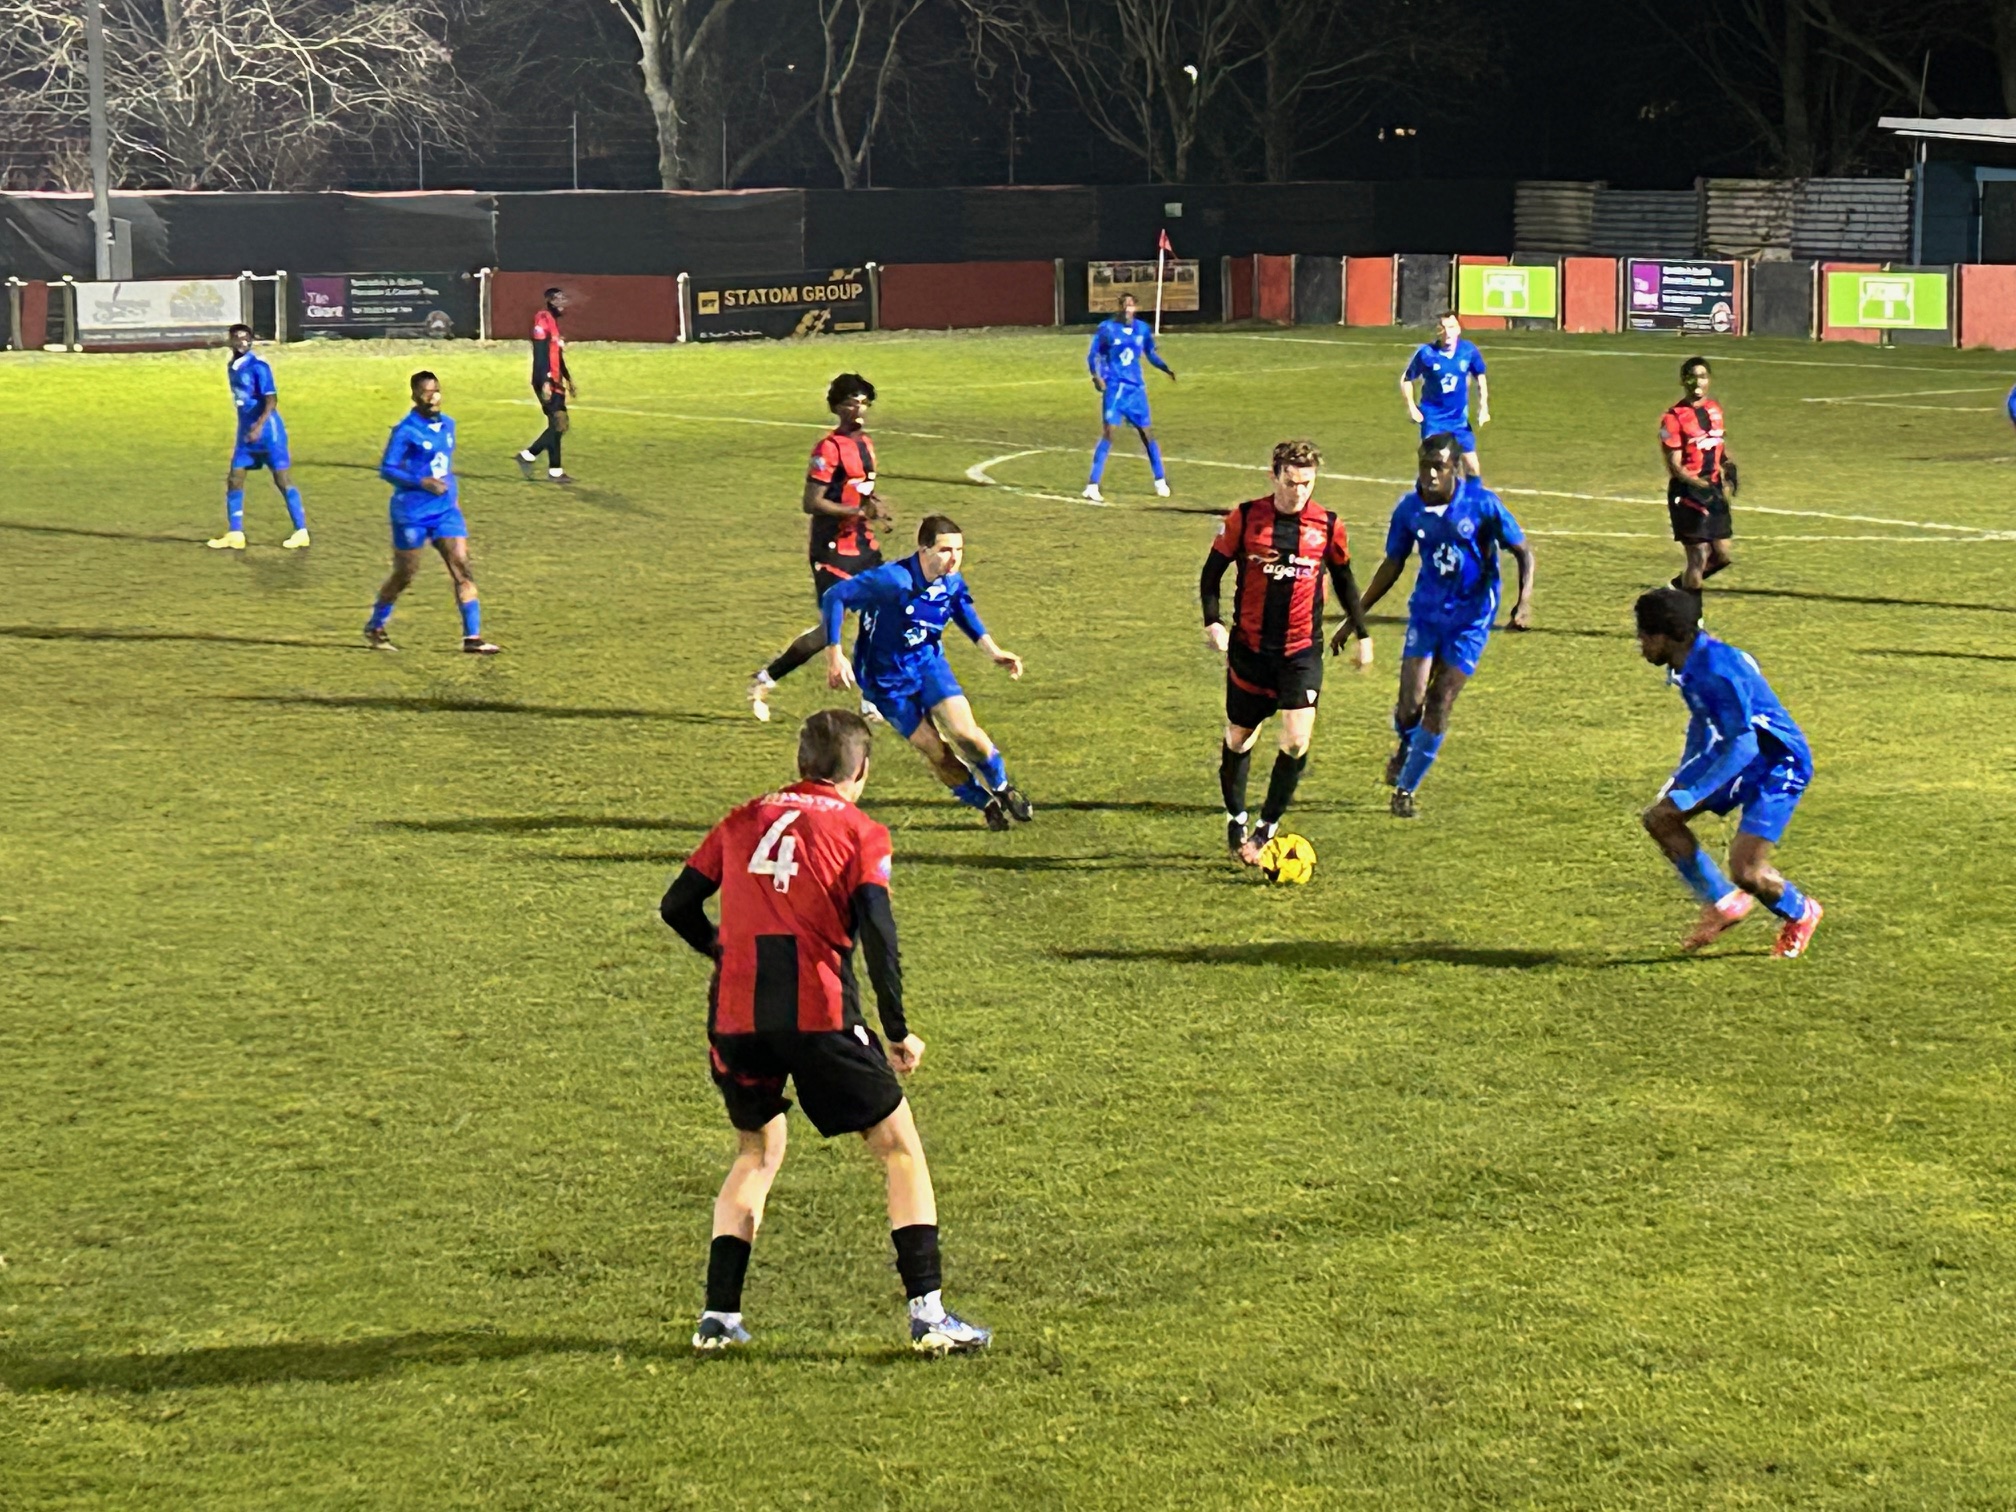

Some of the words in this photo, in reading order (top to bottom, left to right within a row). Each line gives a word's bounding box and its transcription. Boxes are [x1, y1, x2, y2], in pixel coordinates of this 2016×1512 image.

[724, 286, 798, 307] STATOM
[802, 283, 863, 302] GROUP
[747, 810, 801, 894] 4
